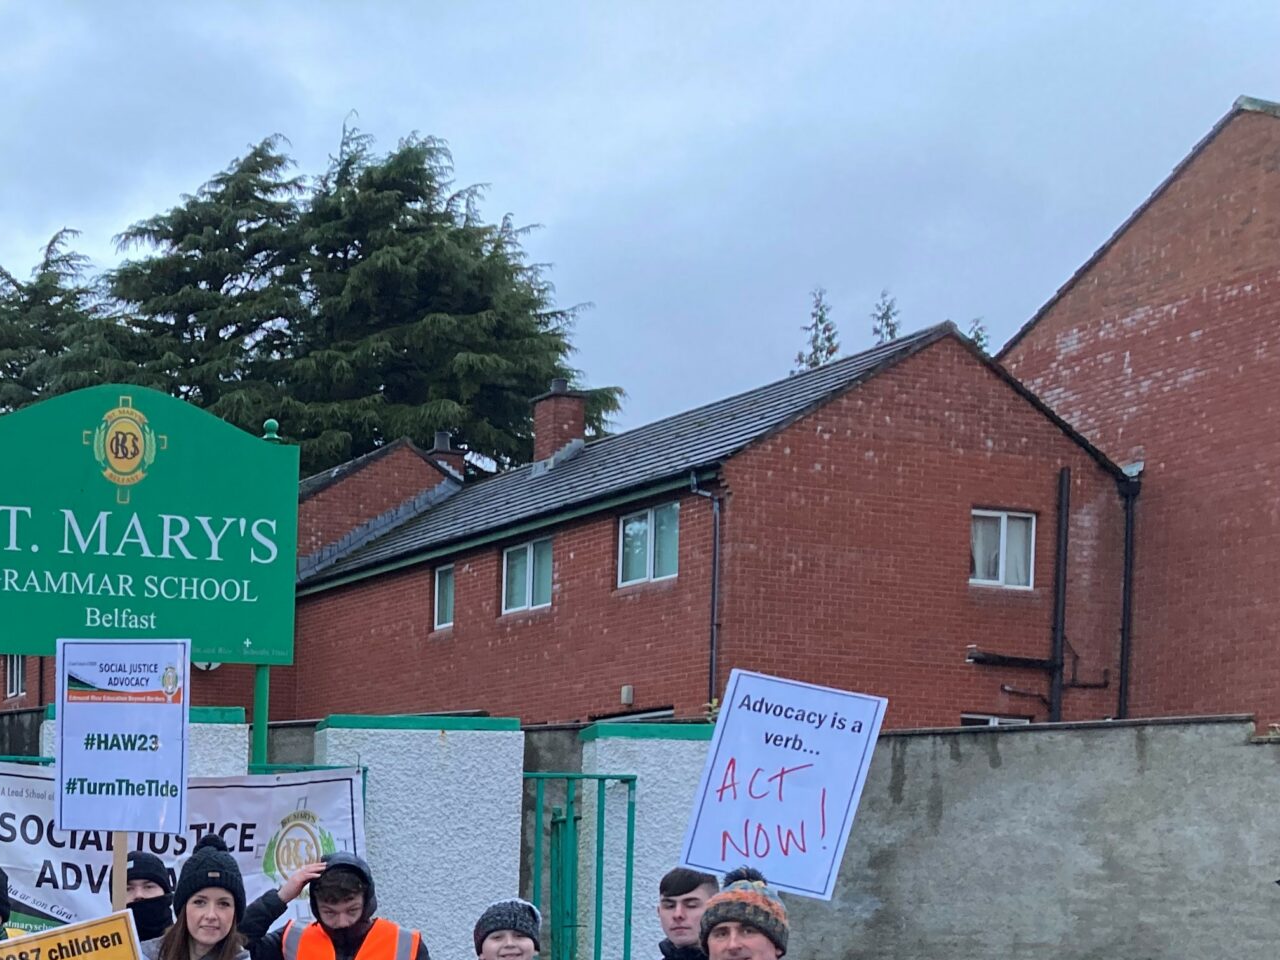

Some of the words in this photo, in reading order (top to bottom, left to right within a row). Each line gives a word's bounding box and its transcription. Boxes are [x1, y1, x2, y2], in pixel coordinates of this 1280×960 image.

[59, 509, 278, 564] MARY'S
[144, 575, 258, 602] SCHOOL
[85, 607, 157, 629] Belfast
[99, 663, 127, 673] SOCIAL
[129, 663, 158, 674] JUSTICE
[107, 677, 150, 686] ADVOCACY
[738, 694, 828, 729] Advocacy
[831, 712, 846, 731] is
[851, 719, 863, 734] a
[84, 733, 159, 752] #HAW23
[764, 731, 820, 756] verb...
[65, 778, 178, 798] #TurnTheTide
[716, 757, 814, 802] ACT
[1, 786, 6, 796] A
[25, 788, 46, 800] School
[721, 787, 827, 862] NOW!
